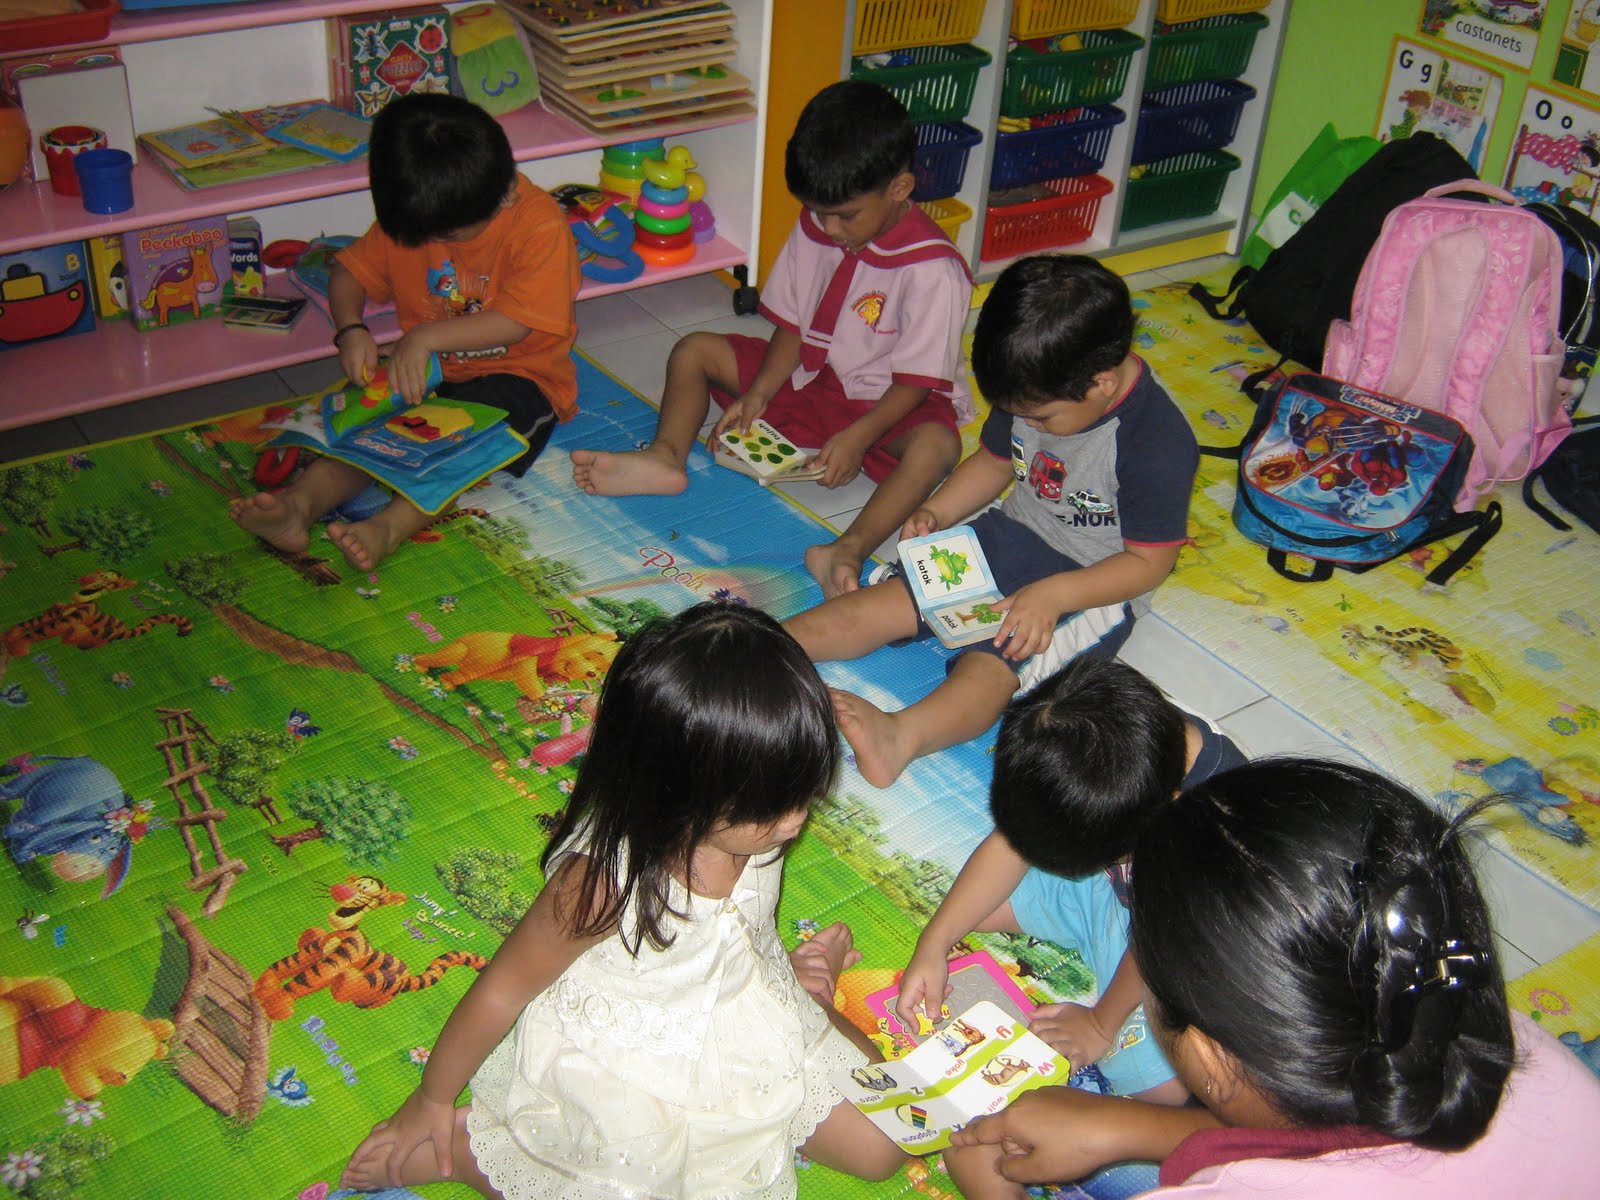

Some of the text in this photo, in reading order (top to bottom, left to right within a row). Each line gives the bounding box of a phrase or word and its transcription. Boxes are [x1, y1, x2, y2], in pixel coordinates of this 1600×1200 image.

[1455, 19, 1522, 53] castanets
[1399, 49, 1433, 83] G g
[480, 67, 520, 97] 3
[1535, 99, 1573, 130] O o
[140, 228, 223, 253] Peekaboo
[65, 253, 81, 271] B
[758, 422, 781, 441] tujuh
[639, 546, 704, 591] Pooh
[916, 559, 932, 585] katak
[940, 614, 958, 629] pokok
[413, 891, 458, 918] Jump!
[415, 908, 477, 940] Bounce!
[995, 1025, 1012, 1039] y
[944, 1058, 965, 1076] yoke
[859, 1094, 881, 1103] zebra
[986, 1095, 1006, 1113] wolf
[901, 1128, 938, 1143] xylophone
